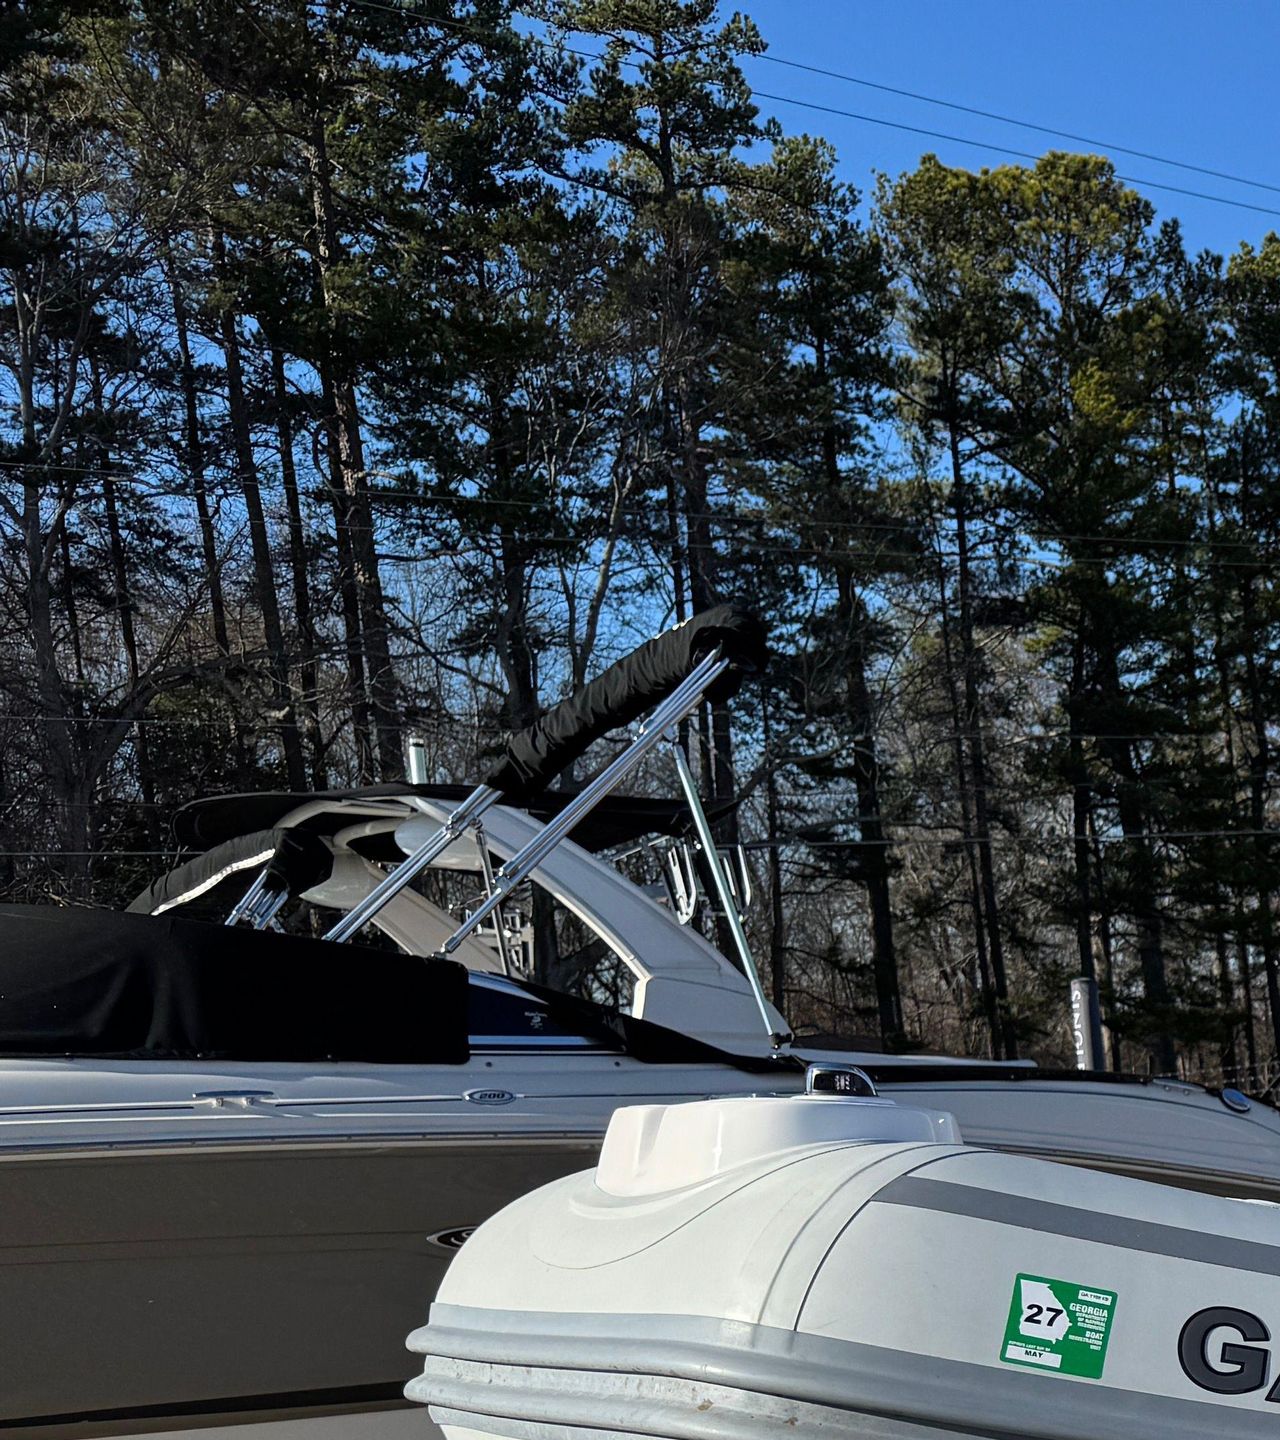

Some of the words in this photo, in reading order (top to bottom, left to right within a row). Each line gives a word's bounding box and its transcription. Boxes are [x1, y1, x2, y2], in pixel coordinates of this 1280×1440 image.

[1023, 1303, 1064, 1327] 27
[1069, 1302, 1108, 1318] GEORGIA
[1085, 1331, 1104, 1340] BOAT
[1024, 1349, 1044, 1358] MAY
